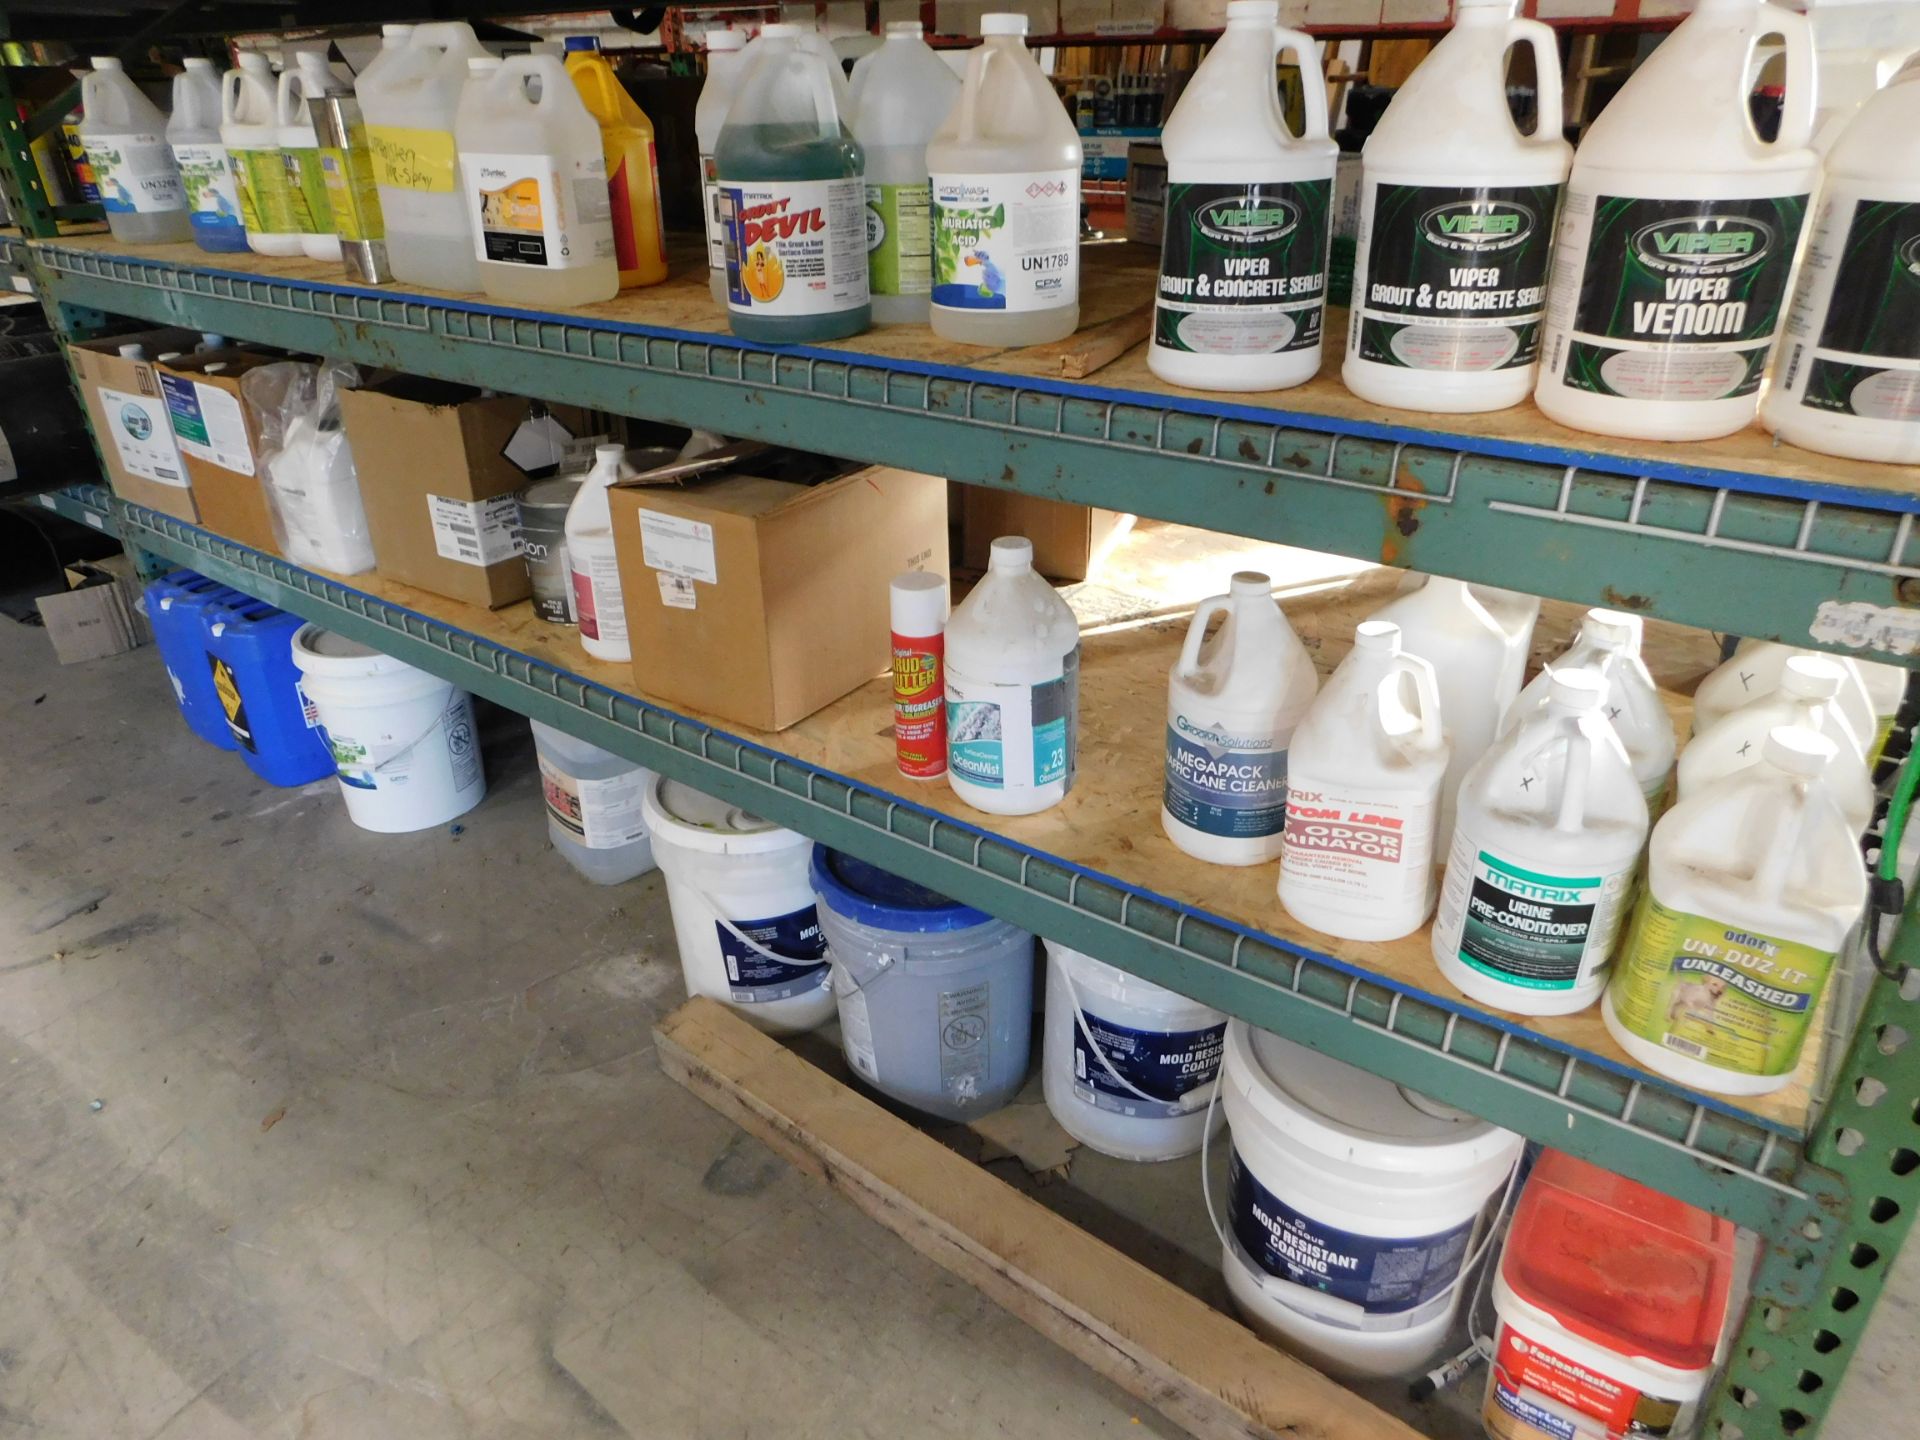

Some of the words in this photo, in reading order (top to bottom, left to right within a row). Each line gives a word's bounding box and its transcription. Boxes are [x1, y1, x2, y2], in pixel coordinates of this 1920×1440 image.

[964, 187, 990, 195] WASH
[744, 207, 826, 247] DEVIL
[941, 216, 992, 230] MURIATIC
[1209, 208, 1285, 226] VIPER
[1436, 214, 1520, 233] VIPER
[951, 235, 978, 247] ACID
[1653, 231, 1755, 254] VIPER
[1021, 254, 1069, 271] UN1789
[1223, 257, 1270, 276] VIPER
[1160, 278, 1195, 296] GROUT
[1196, 273, 1211, 297] &
[1213, 278, 1287, 298] CONCRETE
[1449, 267, 1500, 287] VIPER
[1371, 283, 1415, 306] GROUT
[1416, 283, 1433, 308] &
[1435, 289, 1516, 310] CONCRETE
[1665, 277, 1730, 301] VIPER
[1632, 301, 1748, 336] VENOM
[906, 554, 920, 569] THIS
[920, 548, 932, 561] END
[1218, 735, 1274, 749] Solutions
[952, 750, 1000, 775] OceanMist
[1051, 748, 1064, 769] 23
[1177, 747, 1263, 779] MEGAPACK
[1193, 771, 1227, 791] LANE
[1230, 776, 1288, 793] CLEANER
[1305, 826, 1399, 848] ODOR
[1486, 868, 1583, 903] MATRIX
[1470, 895, 1588, 936] PRE-CONDITIONER
[1508, 898, 1554, 921] URINE
[1723, 930, 1776, 957] odorx
[1682, 958, 1800, 1007] UNLEASHED
[1159, 1052, 1194, 1065] MOLD
[1181, 1056, 1223, 1074] COATIN
[1252, 1203, 1281, 1237] MOLD
[1283, 1227, 1359, 1271] RESISTANT
[1270, 1235, 1328, 1274] COATING
[1529, 1345, 1623, 1395] FastenMaster
[1496, 1383, 1573, 1434] LedgerLok
